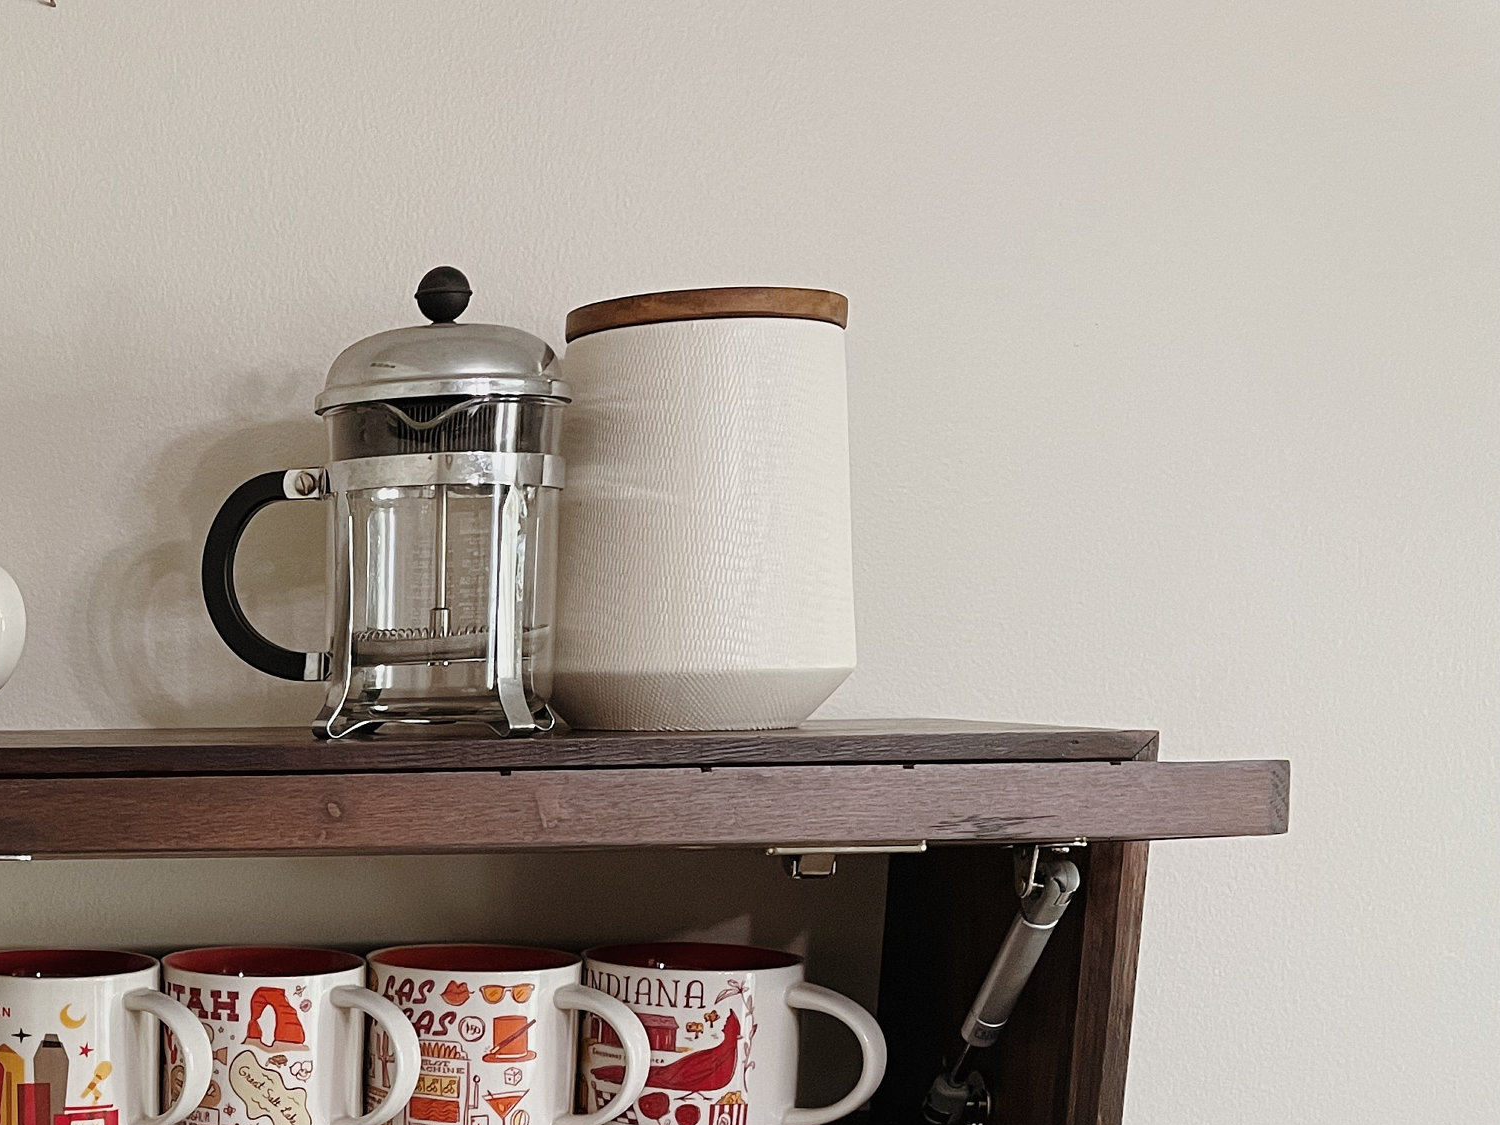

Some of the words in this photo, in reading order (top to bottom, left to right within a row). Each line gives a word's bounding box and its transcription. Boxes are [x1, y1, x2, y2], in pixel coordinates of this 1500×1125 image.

[382, 974, 436, 1006] LAS
[420, 1065, 465, 1075] ACHINE
[238, 1065, 266, 1091] Great
[262, 1088, 281, 1108] Salt
